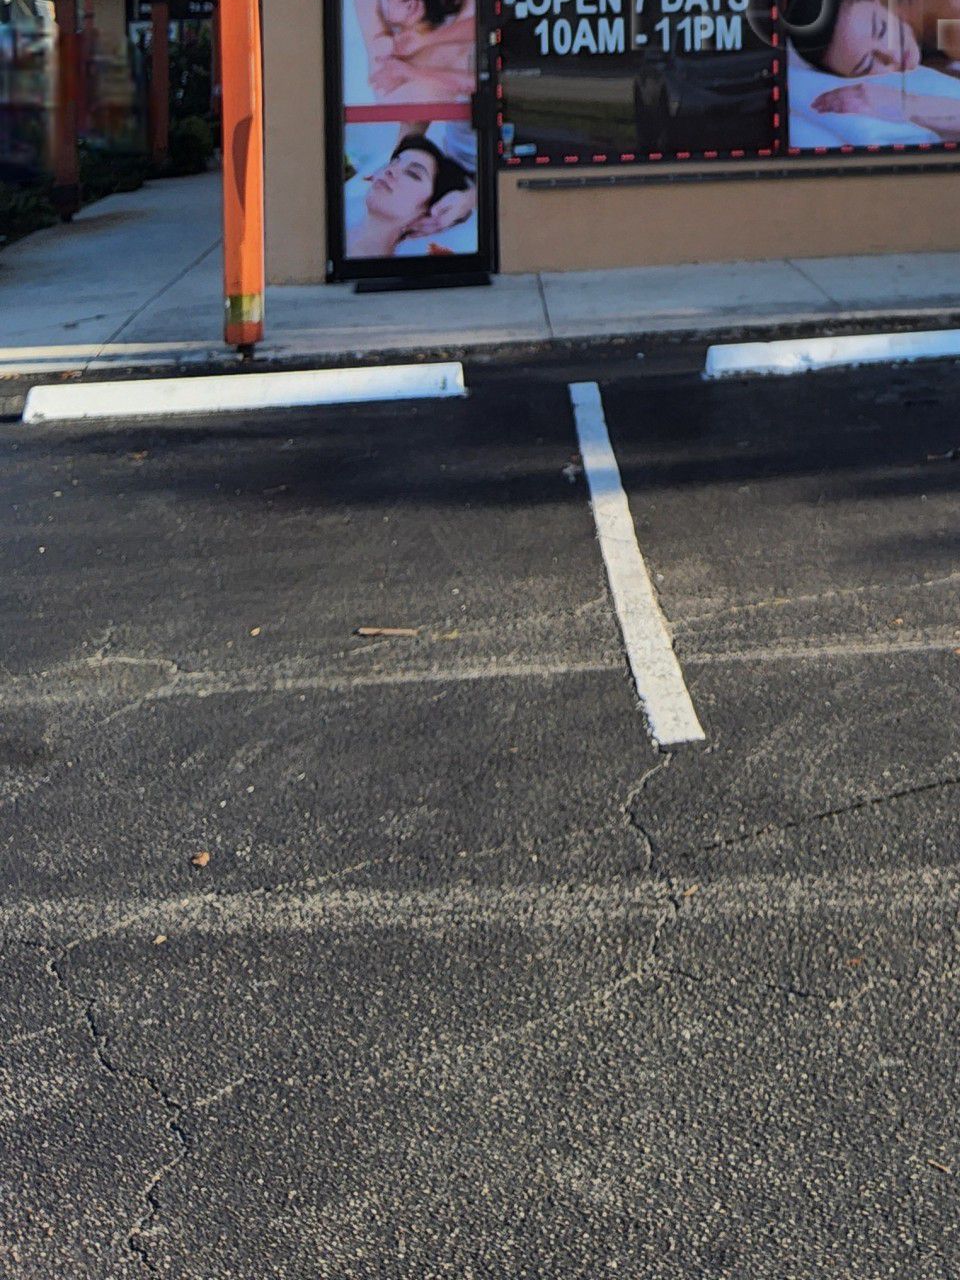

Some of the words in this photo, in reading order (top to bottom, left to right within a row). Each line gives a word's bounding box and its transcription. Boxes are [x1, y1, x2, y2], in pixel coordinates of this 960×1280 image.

[534, 18, 626, 56] 10AM
[635, 34, 648, 45] -
[655, 15, 743, 53] 11PM
